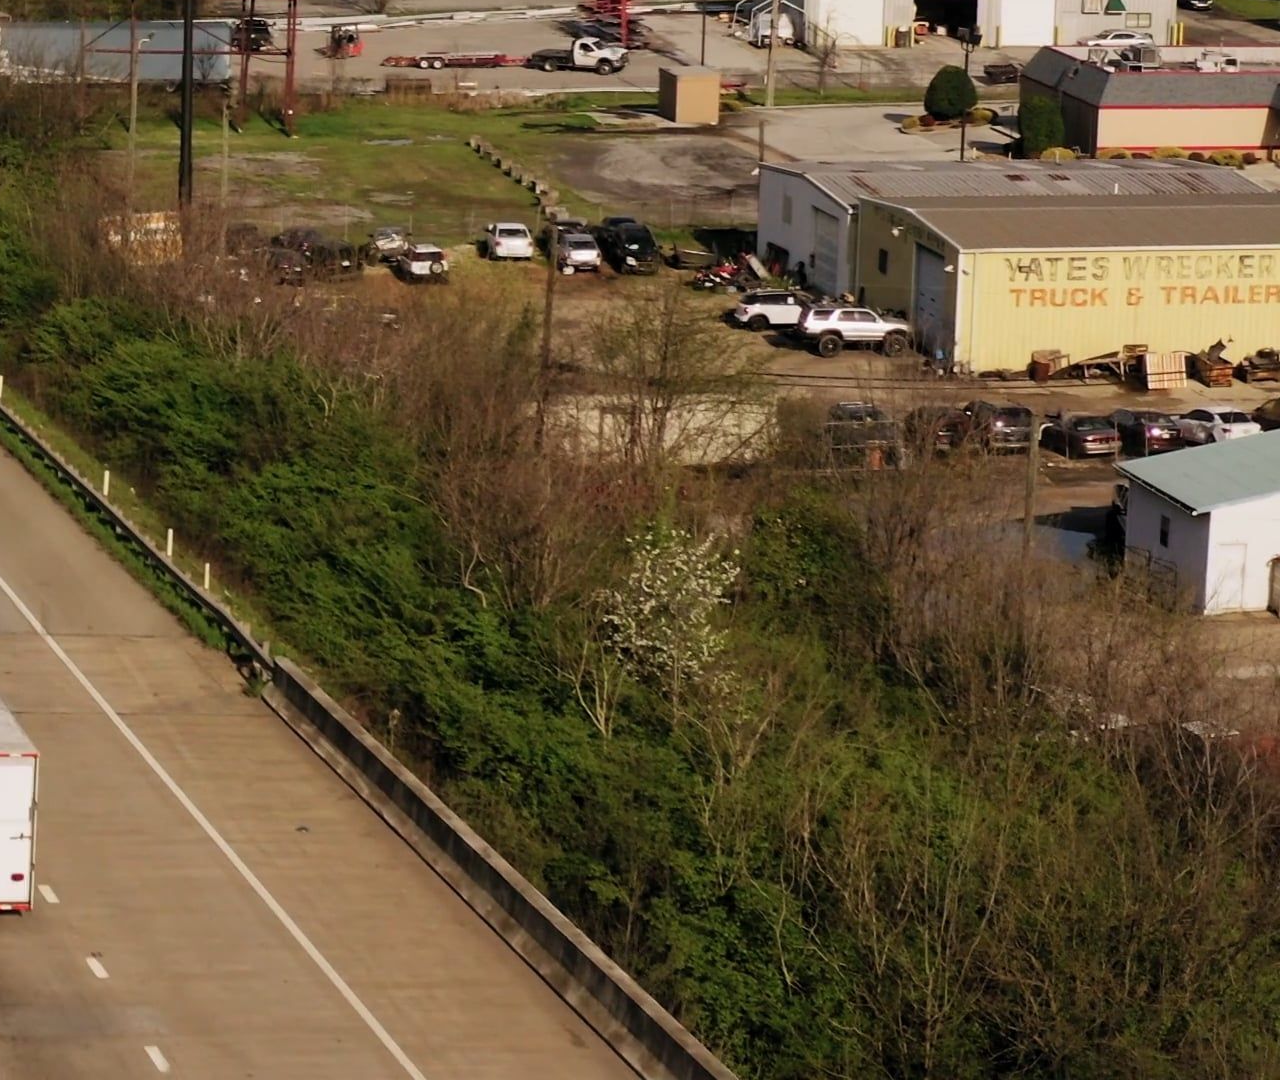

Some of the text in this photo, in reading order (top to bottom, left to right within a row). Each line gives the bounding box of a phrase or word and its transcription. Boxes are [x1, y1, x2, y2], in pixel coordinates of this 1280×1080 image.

[1123, 254, 1276, 280] WRECKER
[1009, 287, 1109, 307] TRUCK
[1126, 287, 1145, 306] &
